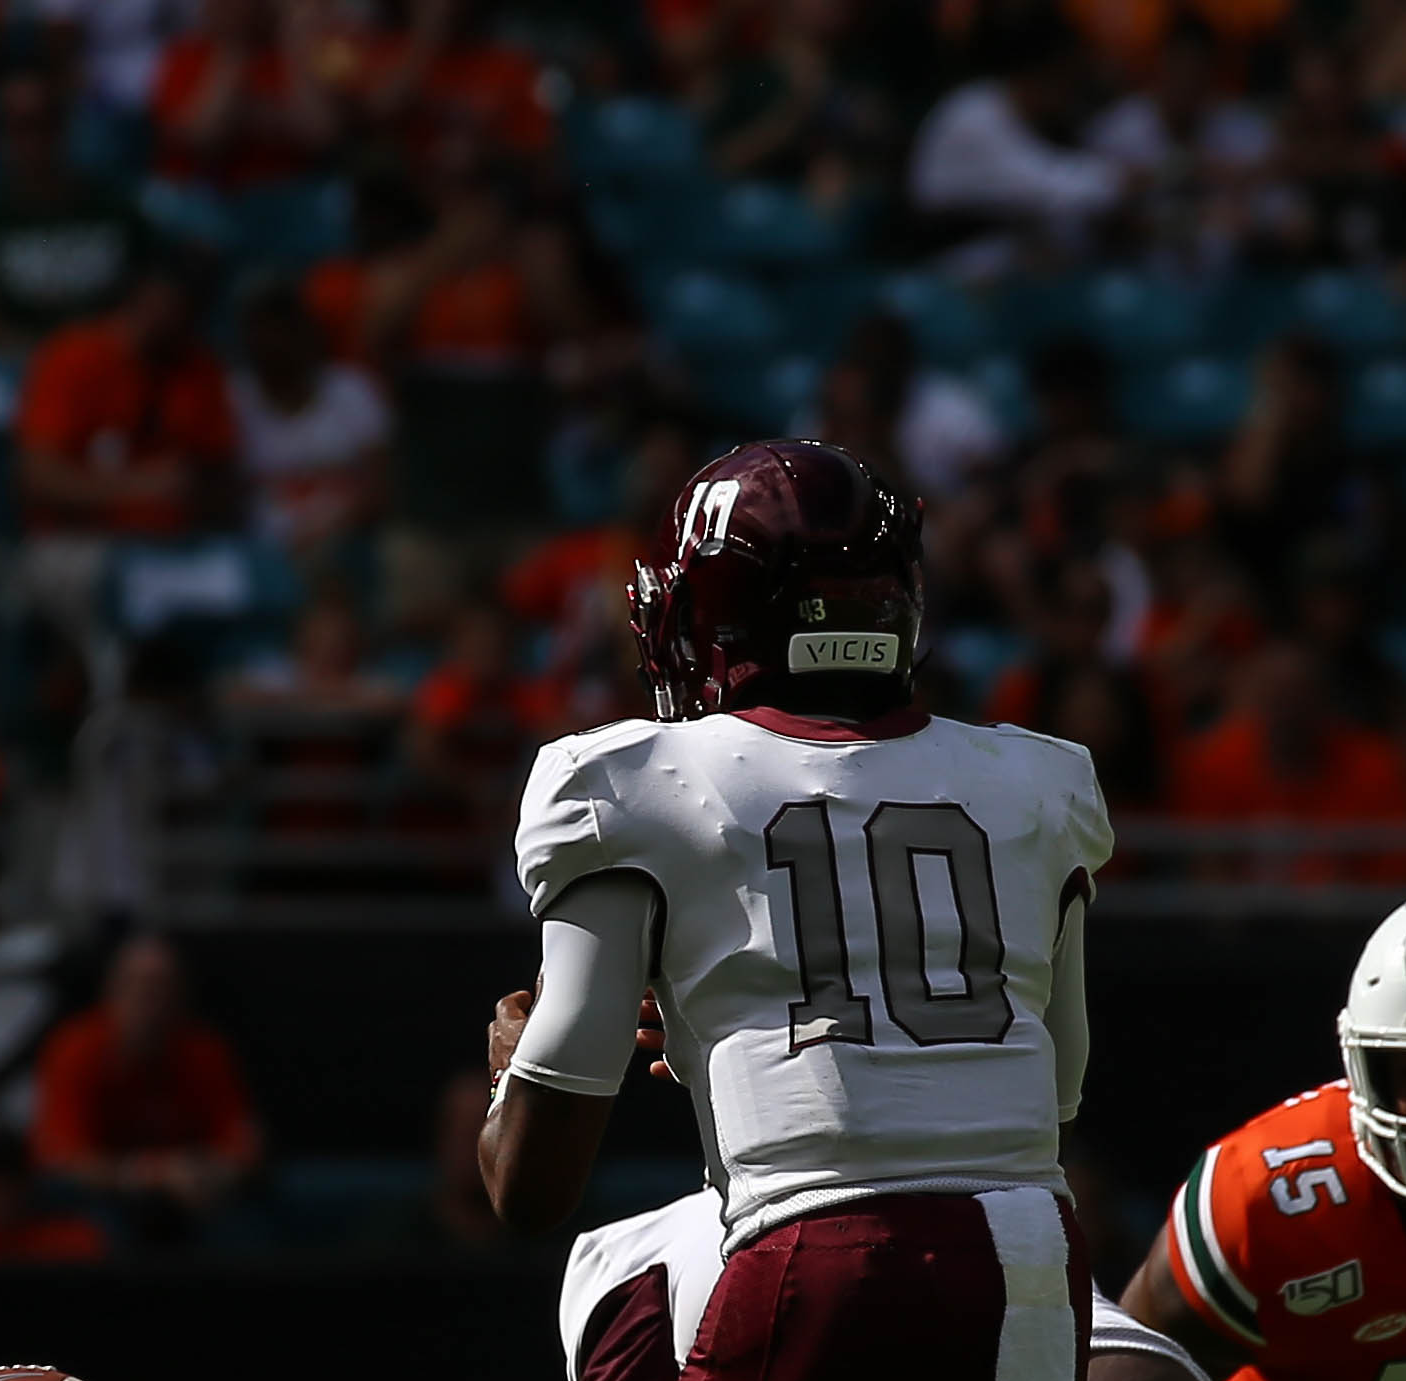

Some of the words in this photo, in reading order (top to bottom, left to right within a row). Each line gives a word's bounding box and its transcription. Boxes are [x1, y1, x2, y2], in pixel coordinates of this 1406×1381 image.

[806, 641, 886, 664] VICIS
[763, 801, 1015, 1052] 10
[1262, 1138, 1348, 1217] 15
